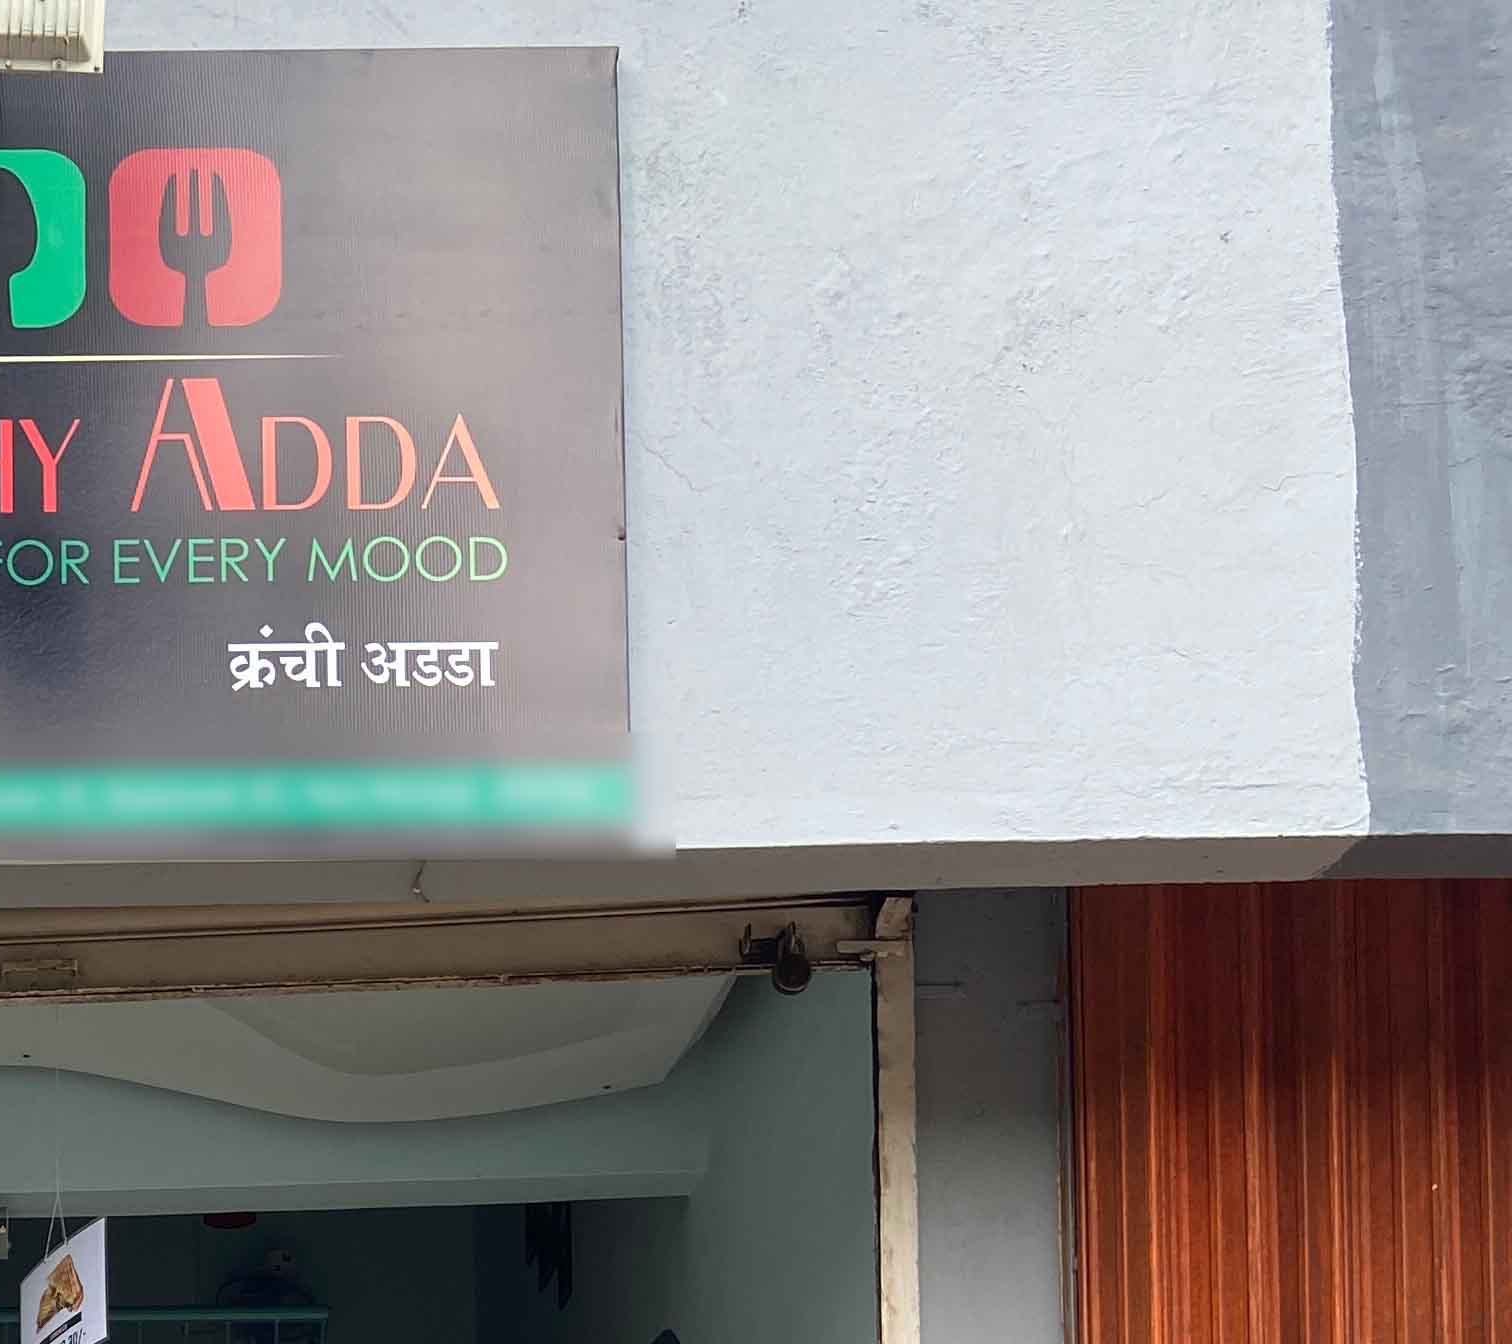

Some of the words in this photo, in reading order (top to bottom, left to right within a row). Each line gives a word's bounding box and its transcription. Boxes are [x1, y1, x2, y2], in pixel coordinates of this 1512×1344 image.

[129, 377, 502, 514] ADDA
[113, 537, 287, 585] EVERY
[307, 535, 509, 584] MOOD
[227, 621, 346, 692] क्रंची
[360, 641, 500, 688] अडडा
